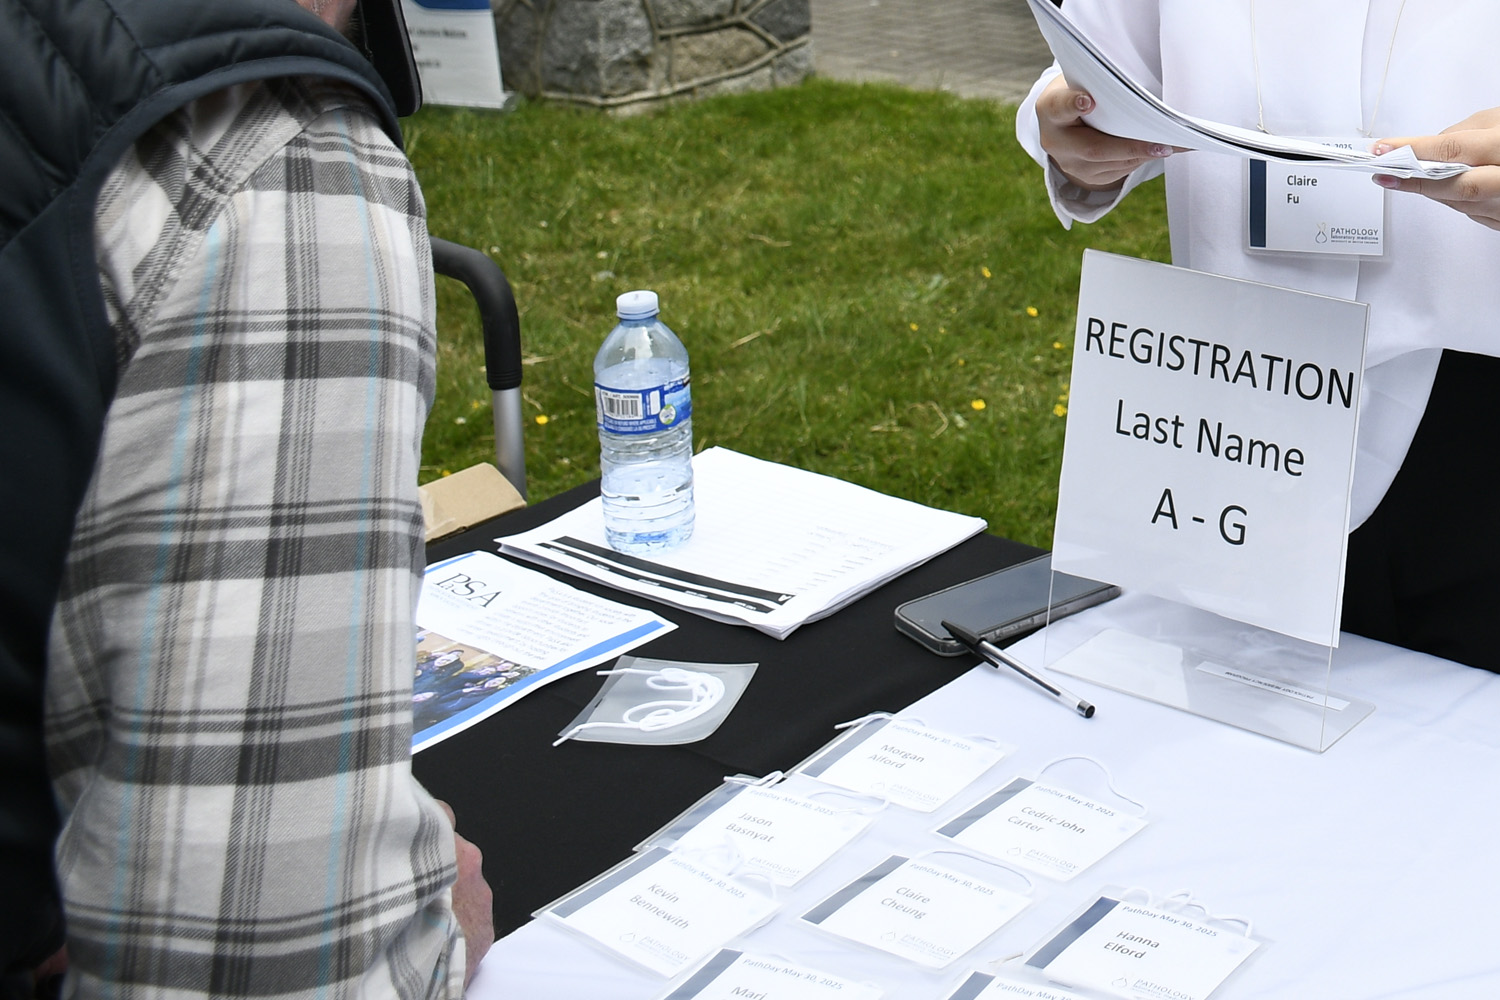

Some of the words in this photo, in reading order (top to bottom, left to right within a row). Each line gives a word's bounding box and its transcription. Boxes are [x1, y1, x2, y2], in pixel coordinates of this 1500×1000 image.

[1287, 174, 1318, 187] Claire
[1287, 193, 1300, 204] Fu
[1331, 227, 1379, 236] PATHOLOGY
[1085, 317, 1354, 408] REGISTRATION
[1115, 399, 1185, 449] Last
[1196, 418, 1305, 477] Name
[1150, 488, 1179, 530] A
[1218, 504, 1248, 546] G
[891, 724, 922, 736] PathDay
[922, 732, 940, 741] May
[952, 742, 972, 751] 2025
[868, 754, 906, 769] Alford
[880, 744, 925, 763] Morgan
[750, 789, 782, 801] PathDay
[782, 796, 801, 806] May
[814, 806, 837, 816] 2025
[1034, 785, 1066, 798] PathDay
[1065, 794, 1084, 805] May
[1095, 806, 1117, 817] 2025
[738, 812, 774, 827] Jason
[1007, 815, 1045, 832] Carter
[1020, 806, 1058, 824] Cedric
[1056, 819, 1086, 834] John
[725, 822, 775, 842] Basnyat
[669, 858, 699, 875] PathDay
[698, 871, 715, 883] May
[726, 886, 747, 899] 2025
[910, 863, 942, 877] PathDay
[942, 872, 961, 883] May
[973, 885, 996, 896] 2025
[647, 883, 680, 904] Kevin
[895, 886, 931, 904] Claire
[629, 894, 689, 929] Bennewith
[880, 897, 927, 920] Cheung
[1122, 905, 1160, 919] PathDay
[1159, 914, 1180, 925] May
[1180, 920, 1193, 930] 30,
[1195, 926, 1219, 937] 2025
[1103, 941, 1147, 959] Elford
[1116, 930, 1161, 949] Hanna
[742, 958, 782, 973] PathDay
[781, 967, 803, 978] May
[803, 973, 818, 983] 30,
[819, 978, 844, 990] 2025
[995, 982, 1035, 997] PathDay
[1035, 991, 1058, 1000] May
